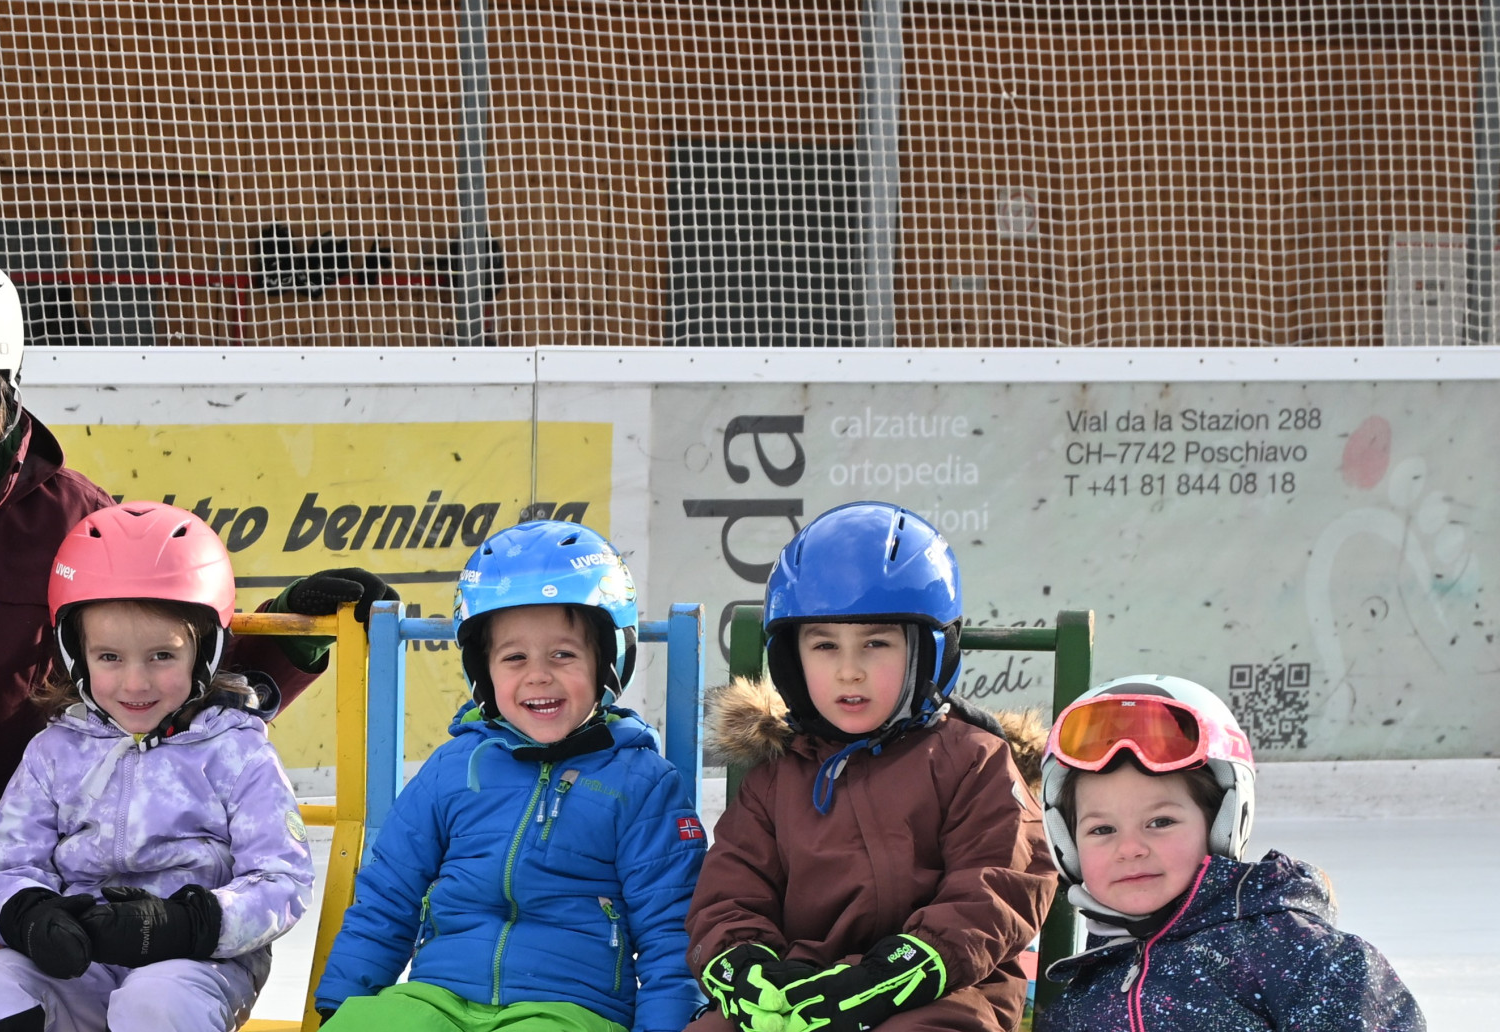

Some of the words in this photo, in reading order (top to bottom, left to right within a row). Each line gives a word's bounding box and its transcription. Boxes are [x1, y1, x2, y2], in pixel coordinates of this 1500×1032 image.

[831, 406, 969, 438] calzature
[1066, 409, 1108, 433] Vial
[1116, 409, 1145, 432] da
[1154, 409, 1173, 432] la
[1181, 407, 1269, 432] Stazion
[1278, 407, 1322, 430] 288
[1066, 441, 1176, 465] CH-7742
[1185, 440, 1308, 464] Poschiavo
[829, 453, 979, 491] ortopedia
[1064, 474, 1080, 496] T
[1088, 474, 1129, 496] +41
[1140, 473, 1166, 495] 81
[1176, 473, 1221, 495] 844
[1229, 472, 1257, 494] 08
[1268, 472, 1296, 493] 18
[55, 562, 76, 581] uvex
[569, 552, 608, 571] uvex
[955, 655, 1033, 702] iedi
